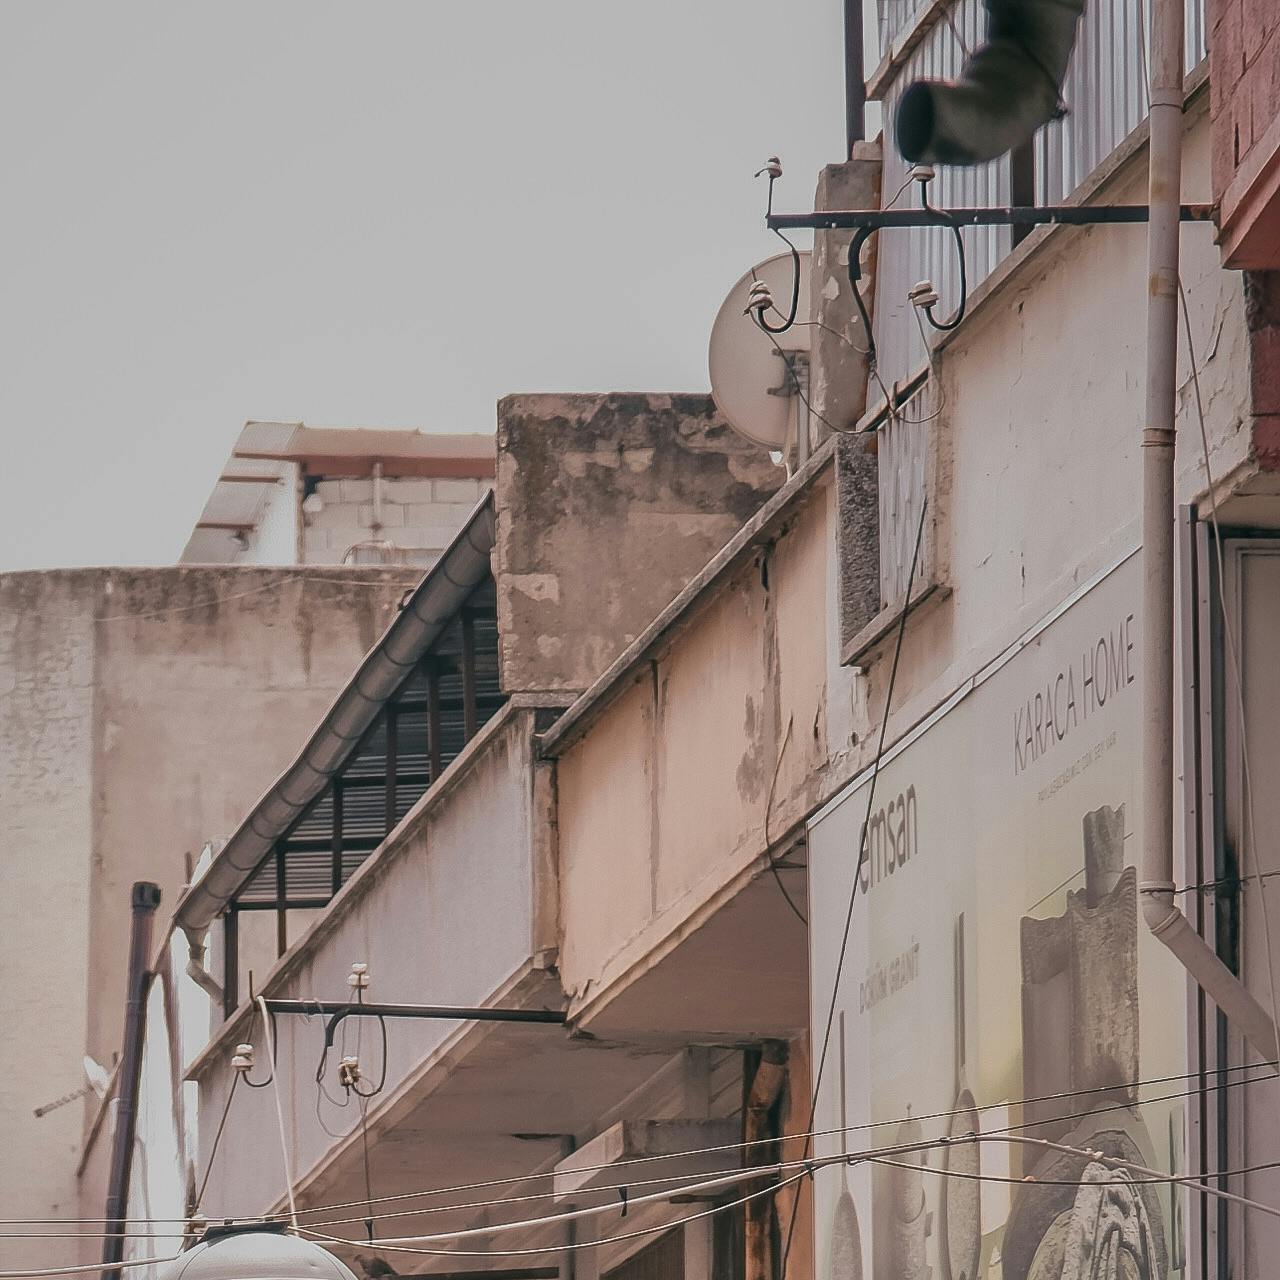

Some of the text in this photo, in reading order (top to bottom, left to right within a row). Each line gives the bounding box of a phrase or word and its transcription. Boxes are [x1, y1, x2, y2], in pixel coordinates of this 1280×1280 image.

[1014, 665, 1078, 776] KARACA
[1083, 614, 1135, 720] HOME
[859, 783, 918, 895] emsan
